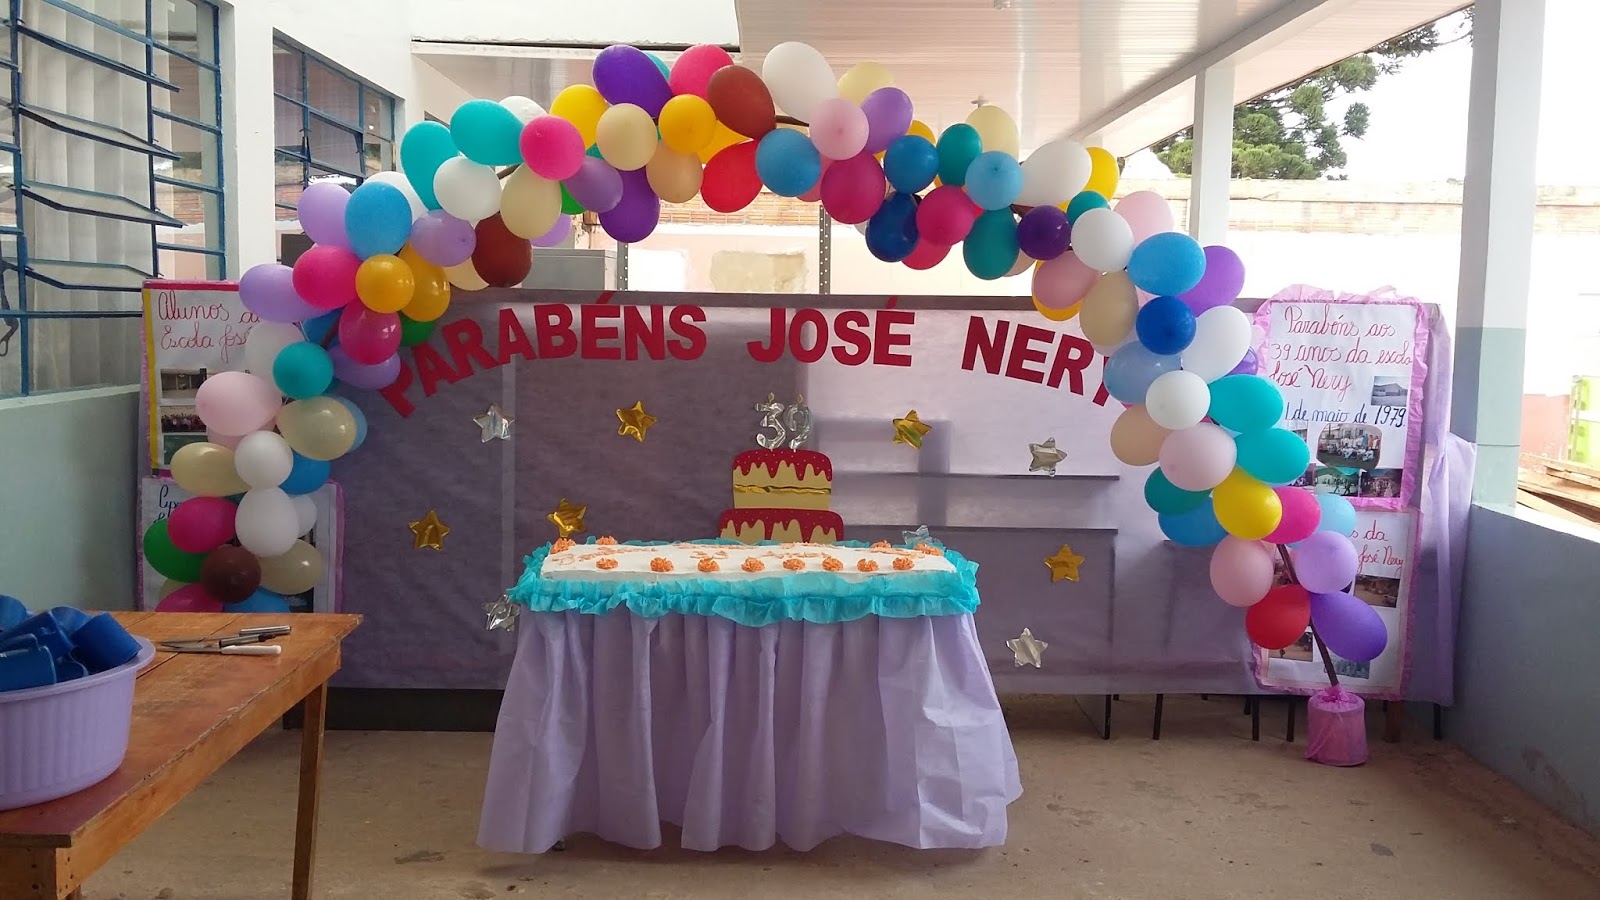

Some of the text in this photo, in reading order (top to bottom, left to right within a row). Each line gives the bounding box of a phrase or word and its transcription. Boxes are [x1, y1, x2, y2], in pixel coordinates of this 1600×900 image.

[158, 291, 230, 322] Alunos
[160, 321, 214, 350] Escola
[1365, 323, 1396, 338] aos
[379, 291, 1112, 418] PARABÉNS JOSÉ NER
[1270, 336, 1413, 366] 39 anos da escola
[1303, 364, 1352, 403] Nery
[1290, 398, 1309, 422] de
[1310, 409, 1350, 424] maio
[1352, 402, 1368, 424] de
[755, 402, 813, 450] 39
[1363, 519, 1389, 542] da
[1382, 545, 1404, 574] Nery
